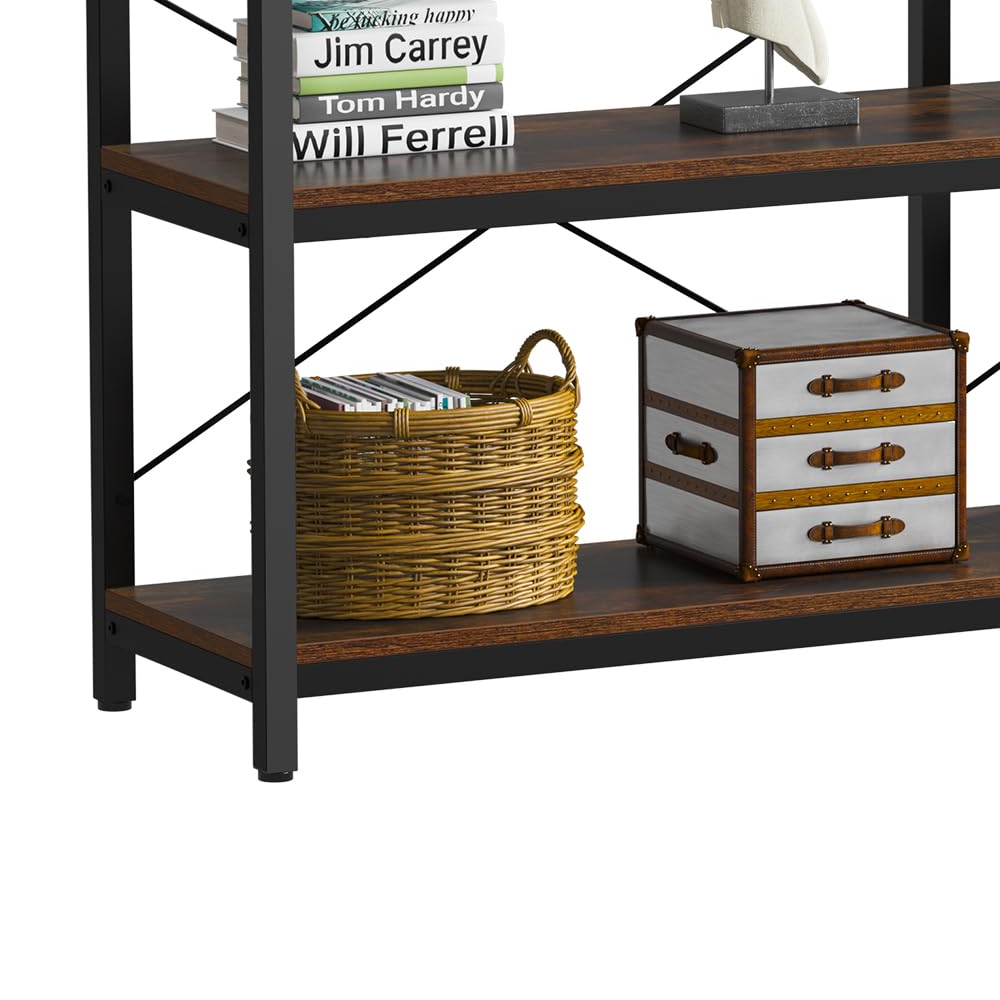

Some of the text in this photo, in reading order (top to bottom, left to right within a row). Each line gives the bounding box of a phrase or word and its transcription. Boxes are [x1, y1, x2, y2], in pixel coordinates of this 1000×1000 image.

[314, 32, 489, 69] Jim Carrey
[318, 86, 486, 115] Tom Hardy
[293, 115, 509, 161] Will Ferrell
